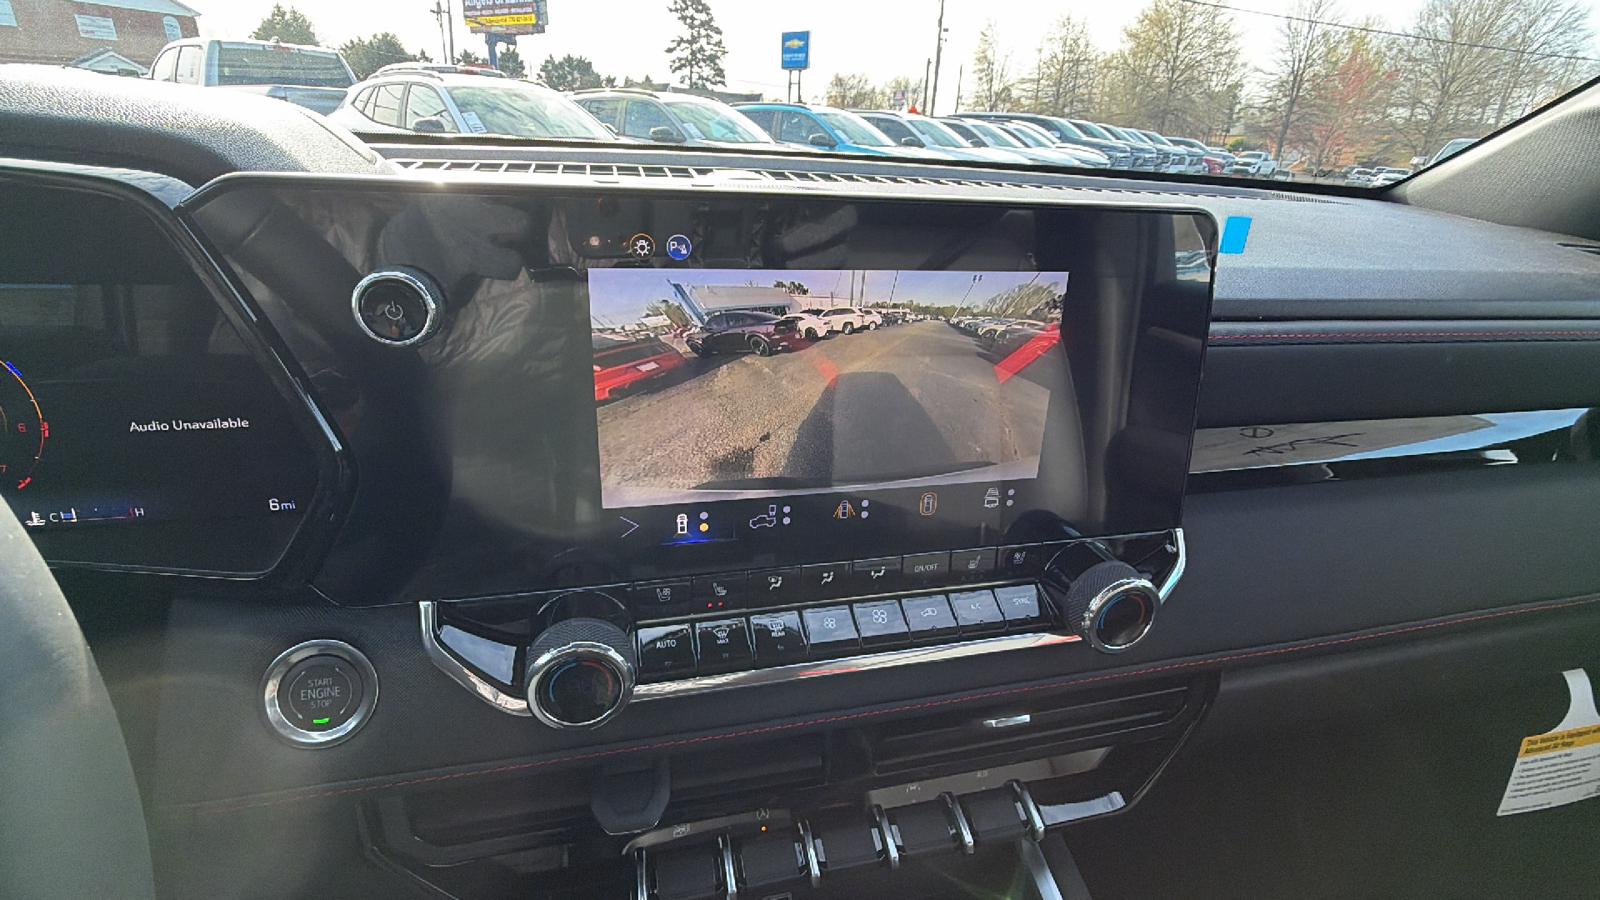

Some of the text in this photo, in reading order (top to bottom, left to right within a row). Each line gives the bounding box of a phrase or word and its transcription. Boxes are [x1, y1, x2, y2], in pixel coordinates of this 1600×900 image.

[17, 422, 27, 433] 6
[129, 417, 249, 433] Audio Unavailable
[50, 512, 59, 523] C
[134, 508, 144, 517] H
[914, 563, 939, 573] ON/OFF
[1013, 597, 1031, 606] SYNC
[970, 603, 982, 611] A/C
[771, 630, 786, 638] REAR
[656, 639, 677, 649] AUTO
[717, 637, 730, 645] MAX
[307, 677, 333, 688] START
[300, 686, 341, 701] ENGINE
[311, 699, 333, 709] STOP
